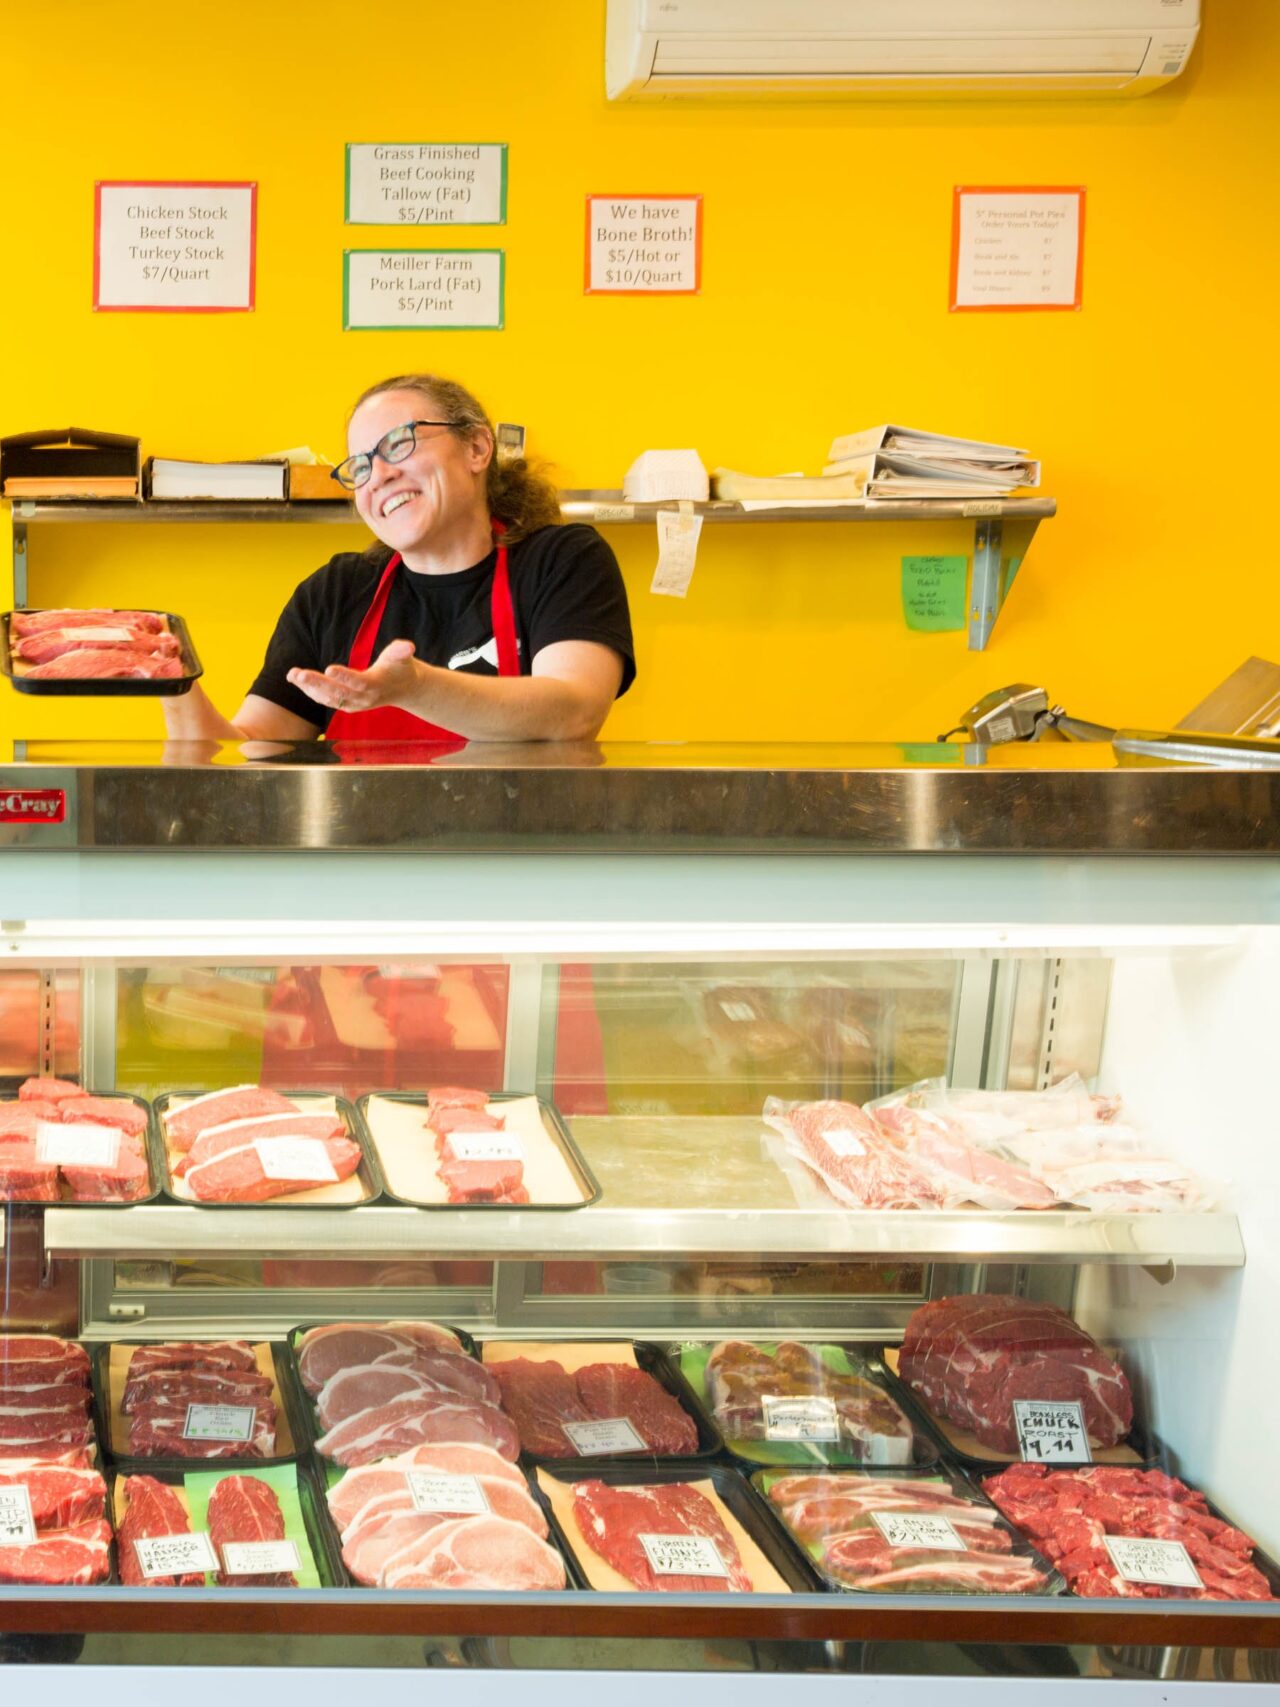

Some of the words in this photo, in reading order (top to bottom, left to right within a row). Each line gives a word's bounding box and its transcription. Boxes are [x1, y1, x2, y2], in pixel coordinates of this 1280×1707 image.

[374, 147, 414, 160] Grass
[419, 147, 480, 160] Finished
[379, 167, 416, 180] Beef
[416, 167, 475, 182] Cooking
[382, 187, 431, 201] Tallow
[436, 187, 471, 203] (Fat)
[127, 206, 184, 220] Chicken
[188, 206, 228, 220] Stock
[398, 207, 454, 223] $5/Pint
[611, 205, 636, 219] We
[642, 204, 679, 219] have
[140, 226, 171, 239] Beef
[175, 226, 215, 240] Stock
[597, 228, 637, 242] Bone
[643, 227, 692, 241] Broth!
[129, 246, 181, 262] Turkey
[185, 246, 224, 260] Stock
[608, 248, 660, 264] $5/Hot
[664, 252, 681, 262] or
[380, 257, 430, 271] Meiller
[435, 257, 472, 271] Farm
[142, 265, 210, 282] $7/Quart
[605, 269, 682, 285] $10/Quart
[370, 277, 404, 290] Pork
[409, 277, 442, 290] Lard
[446, 277, 481, 293] (Fat)
[398, 297, 453, 313] $5/Pint
[1023, 1418, 1080, 1429] CHUCK
[1024, 1430, 1079, 1439] ROAST
